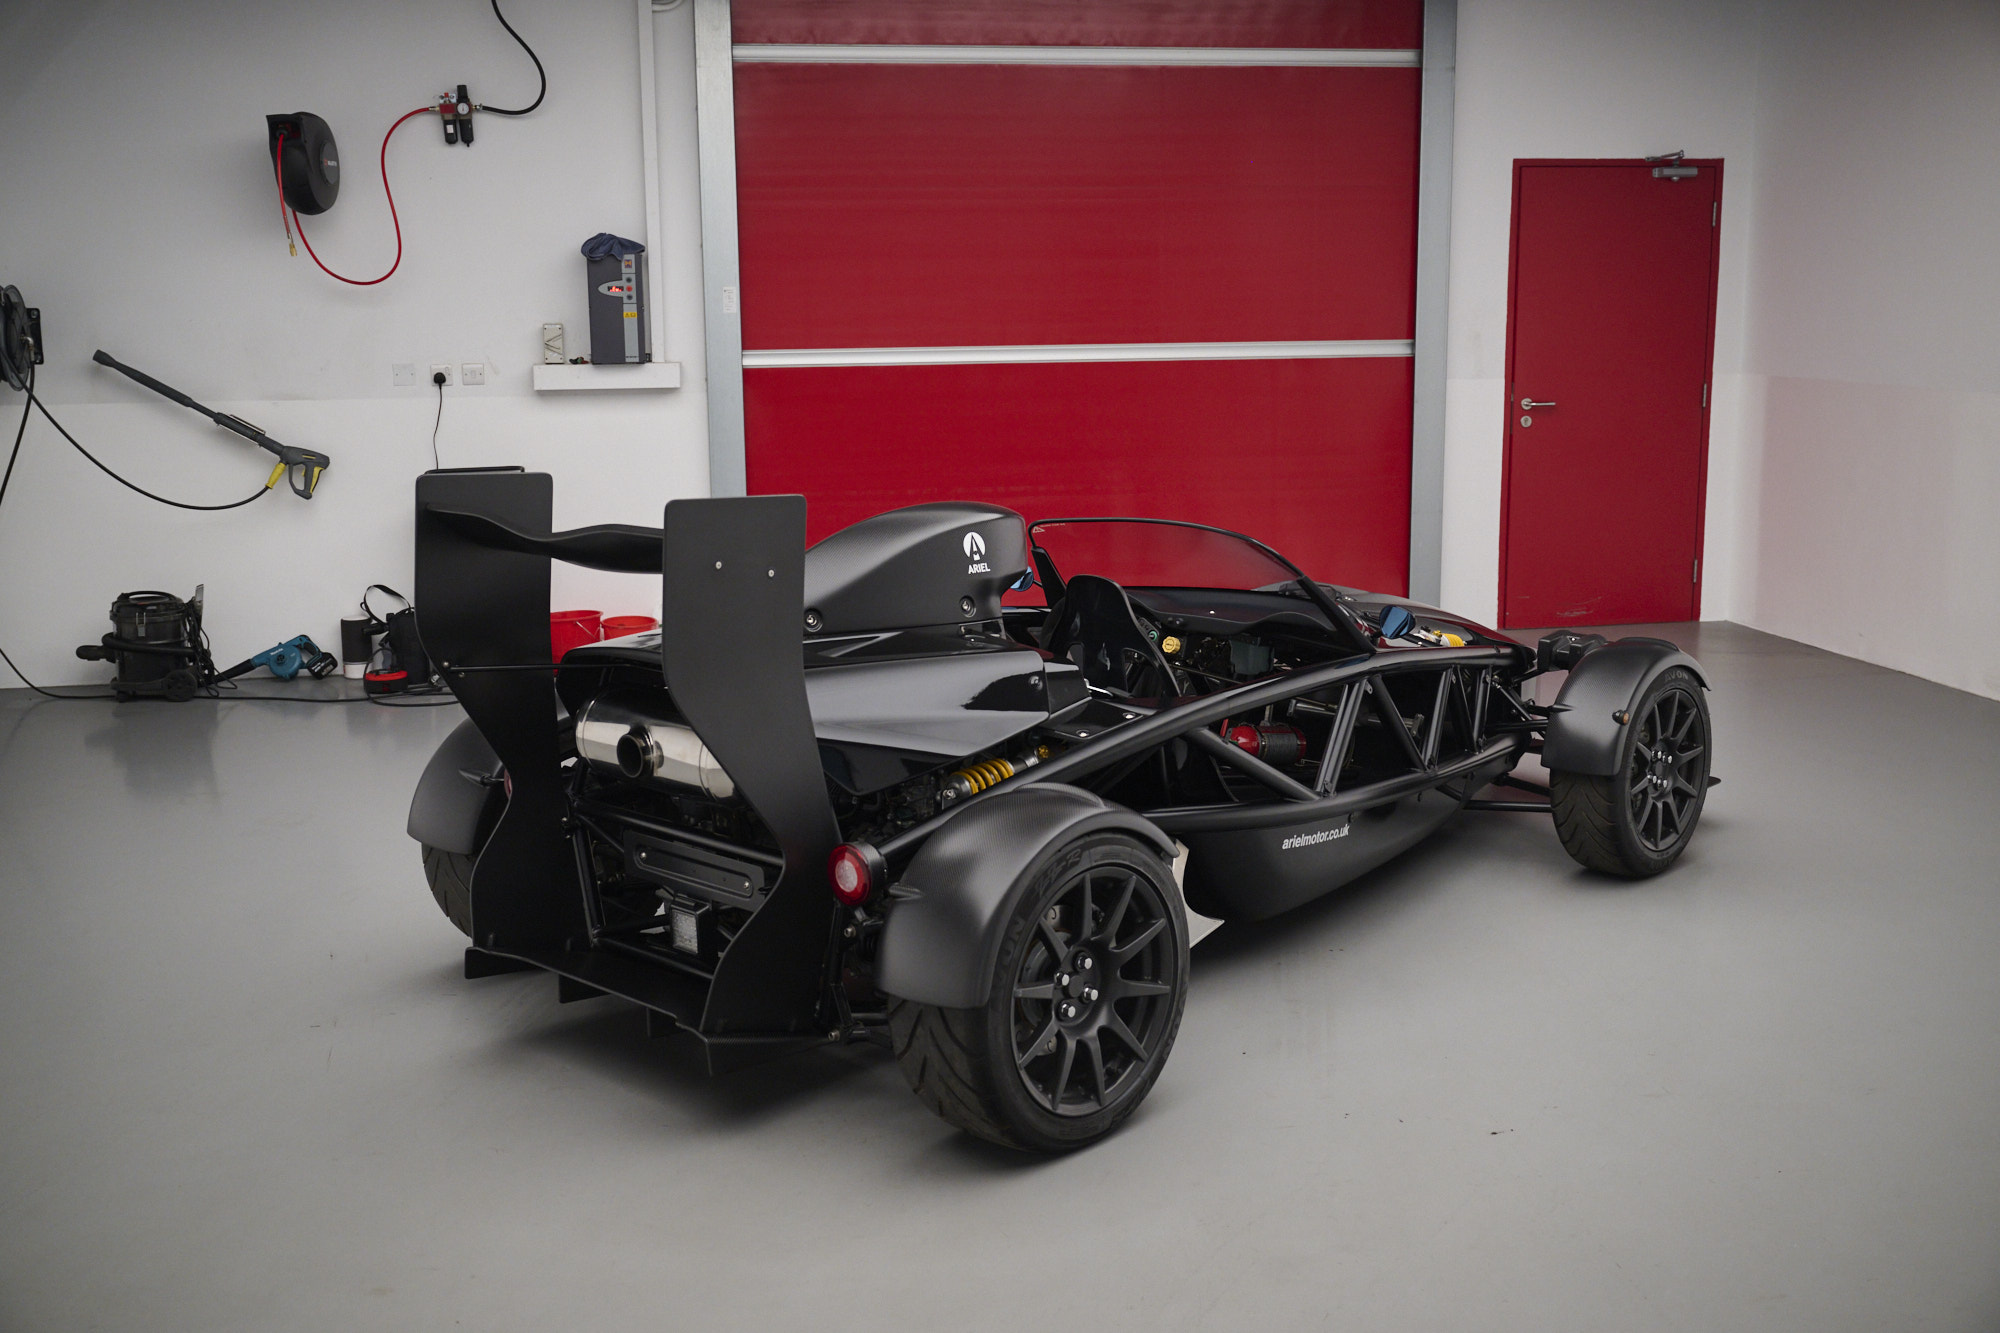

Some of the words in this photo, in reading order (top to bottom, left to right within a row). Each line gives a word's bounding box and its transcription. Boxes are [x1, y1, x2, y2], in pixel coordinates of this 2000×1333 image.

[968, 562, 991, 575] ARIEL
[1664, 670, 1689, 682] AVON
[1281, 823, 1350, 850] arielmotor.co.uk
